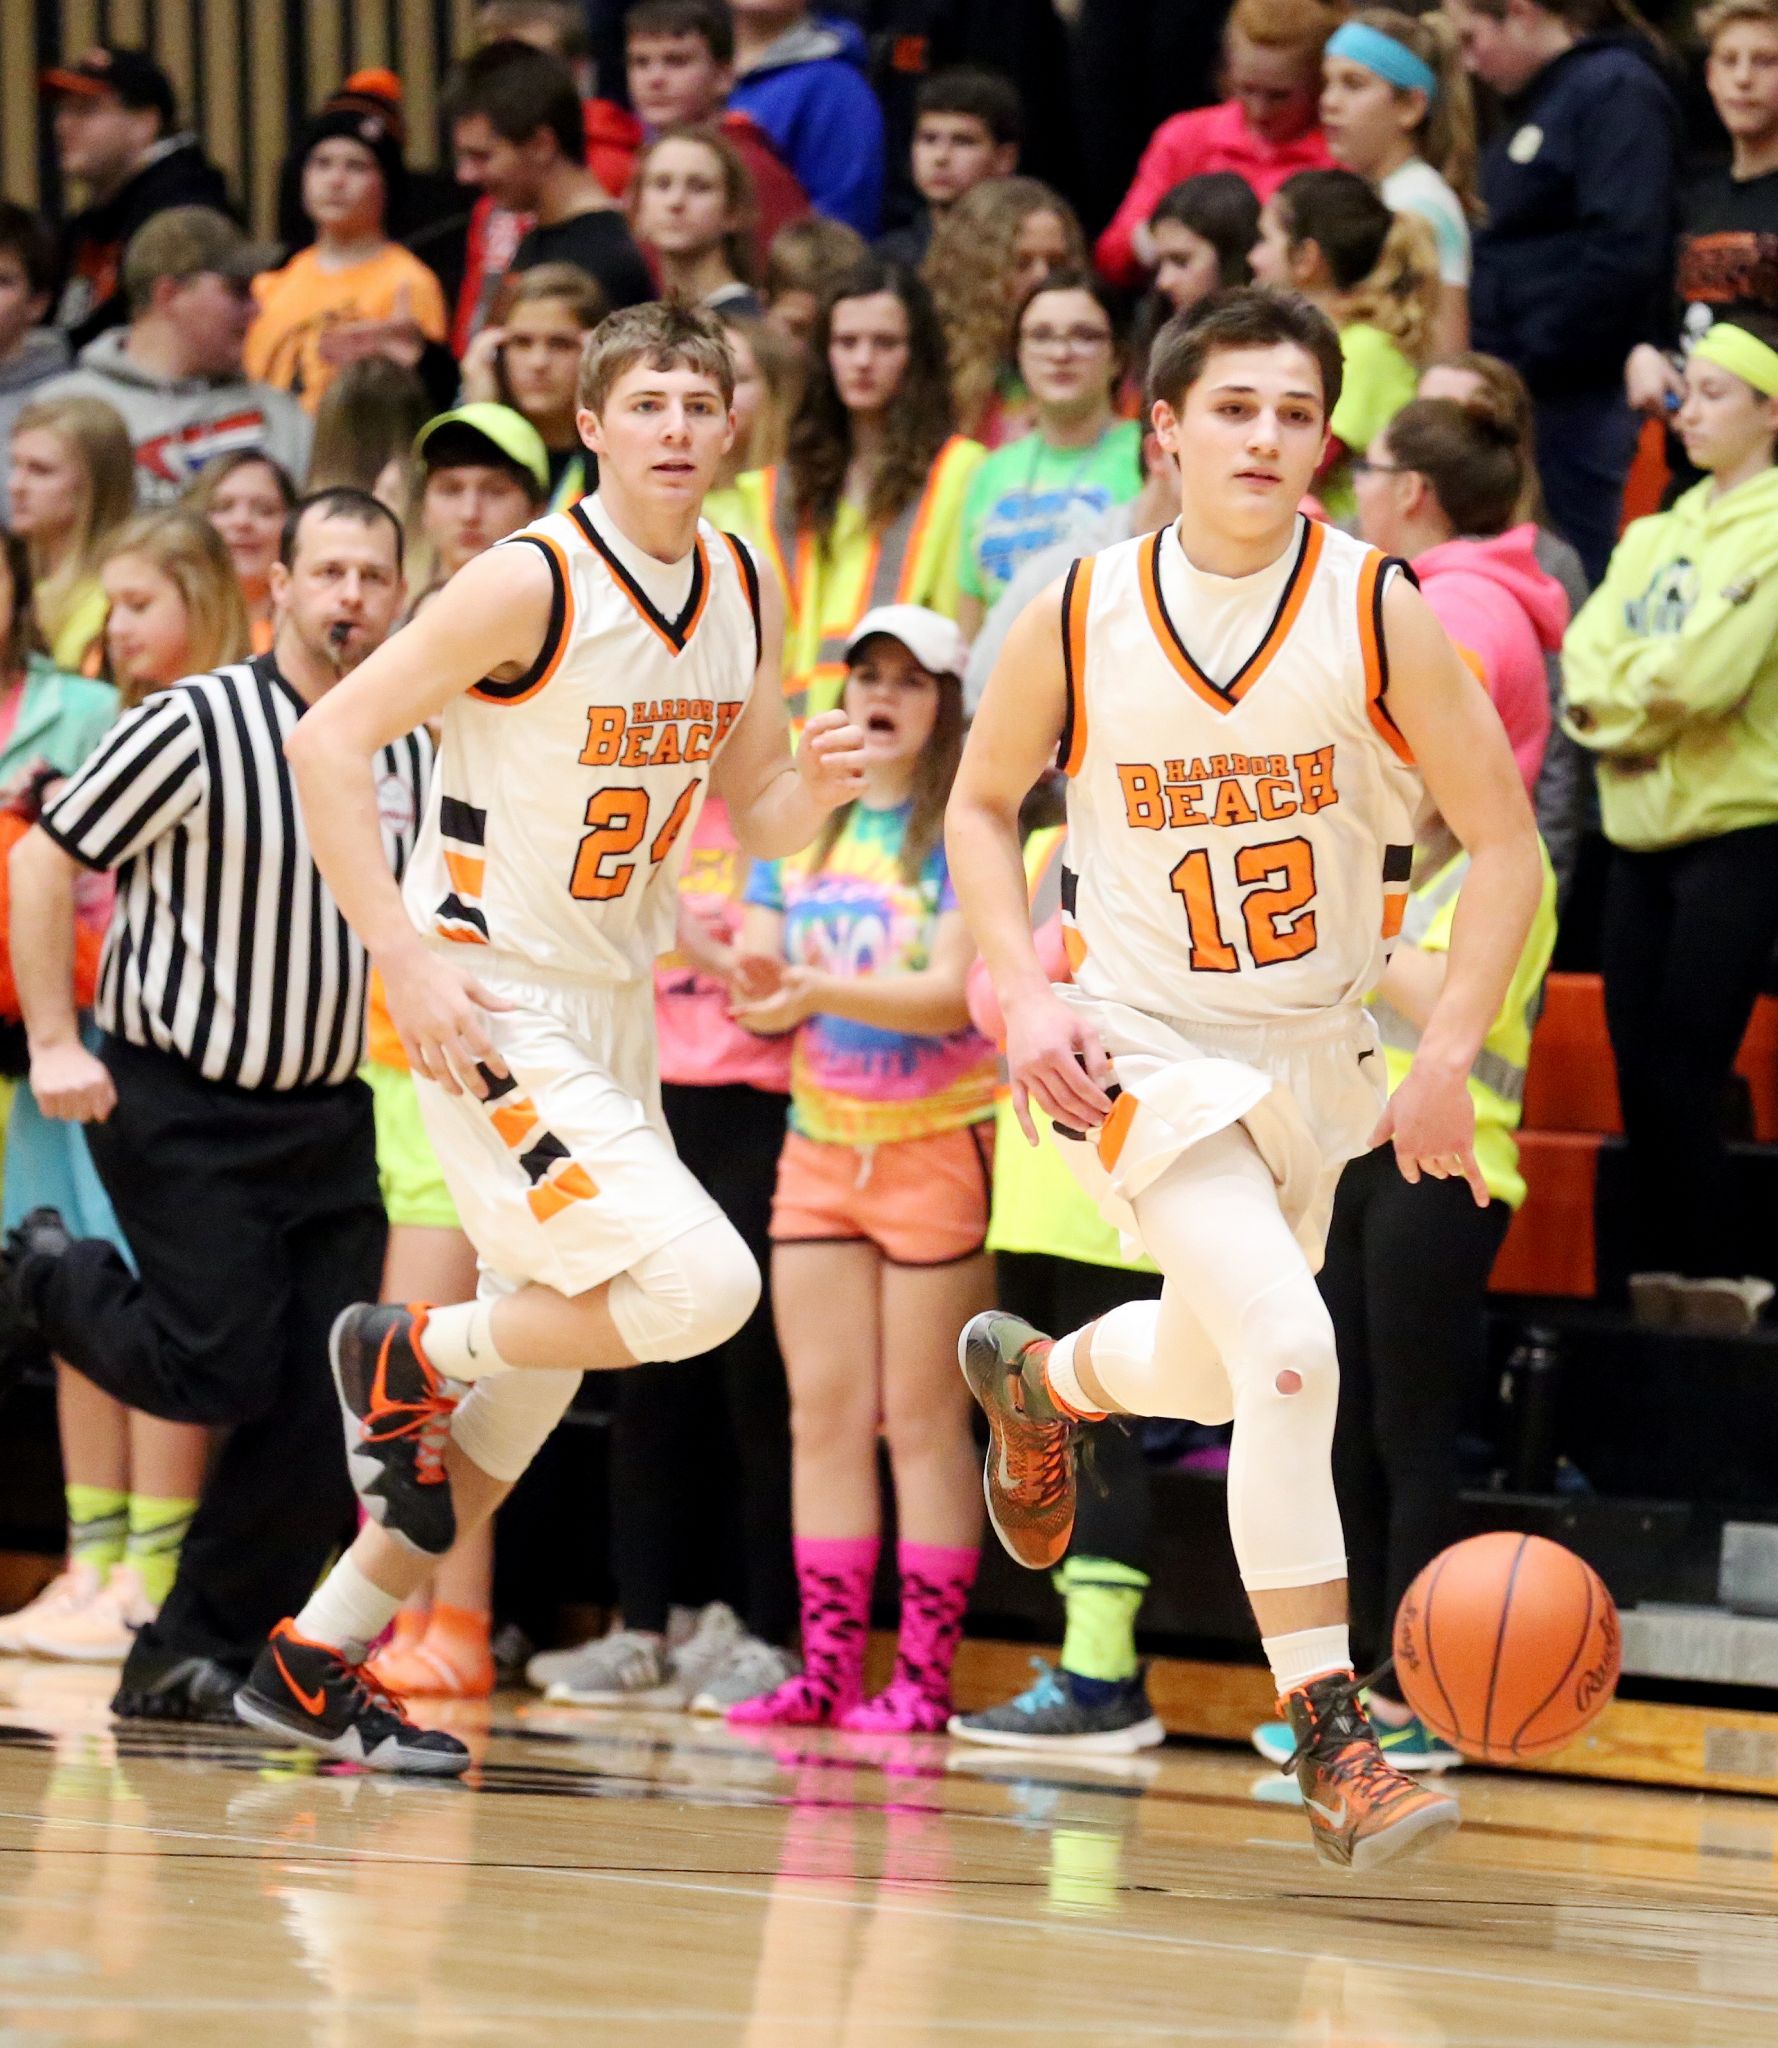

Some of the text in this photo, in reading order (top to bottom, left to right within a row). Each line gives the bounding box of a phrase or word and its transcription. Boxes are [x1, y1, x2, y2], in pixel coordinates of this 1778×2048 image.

[578, 701, 743, 768] BEACH
[633, 698, 714, 723] HARBOR
[1116, 744, 1339, 831] BEACH
[1164, 753, 1290, 783] HARBOR
[1169, 835, 1318, 973] 12
